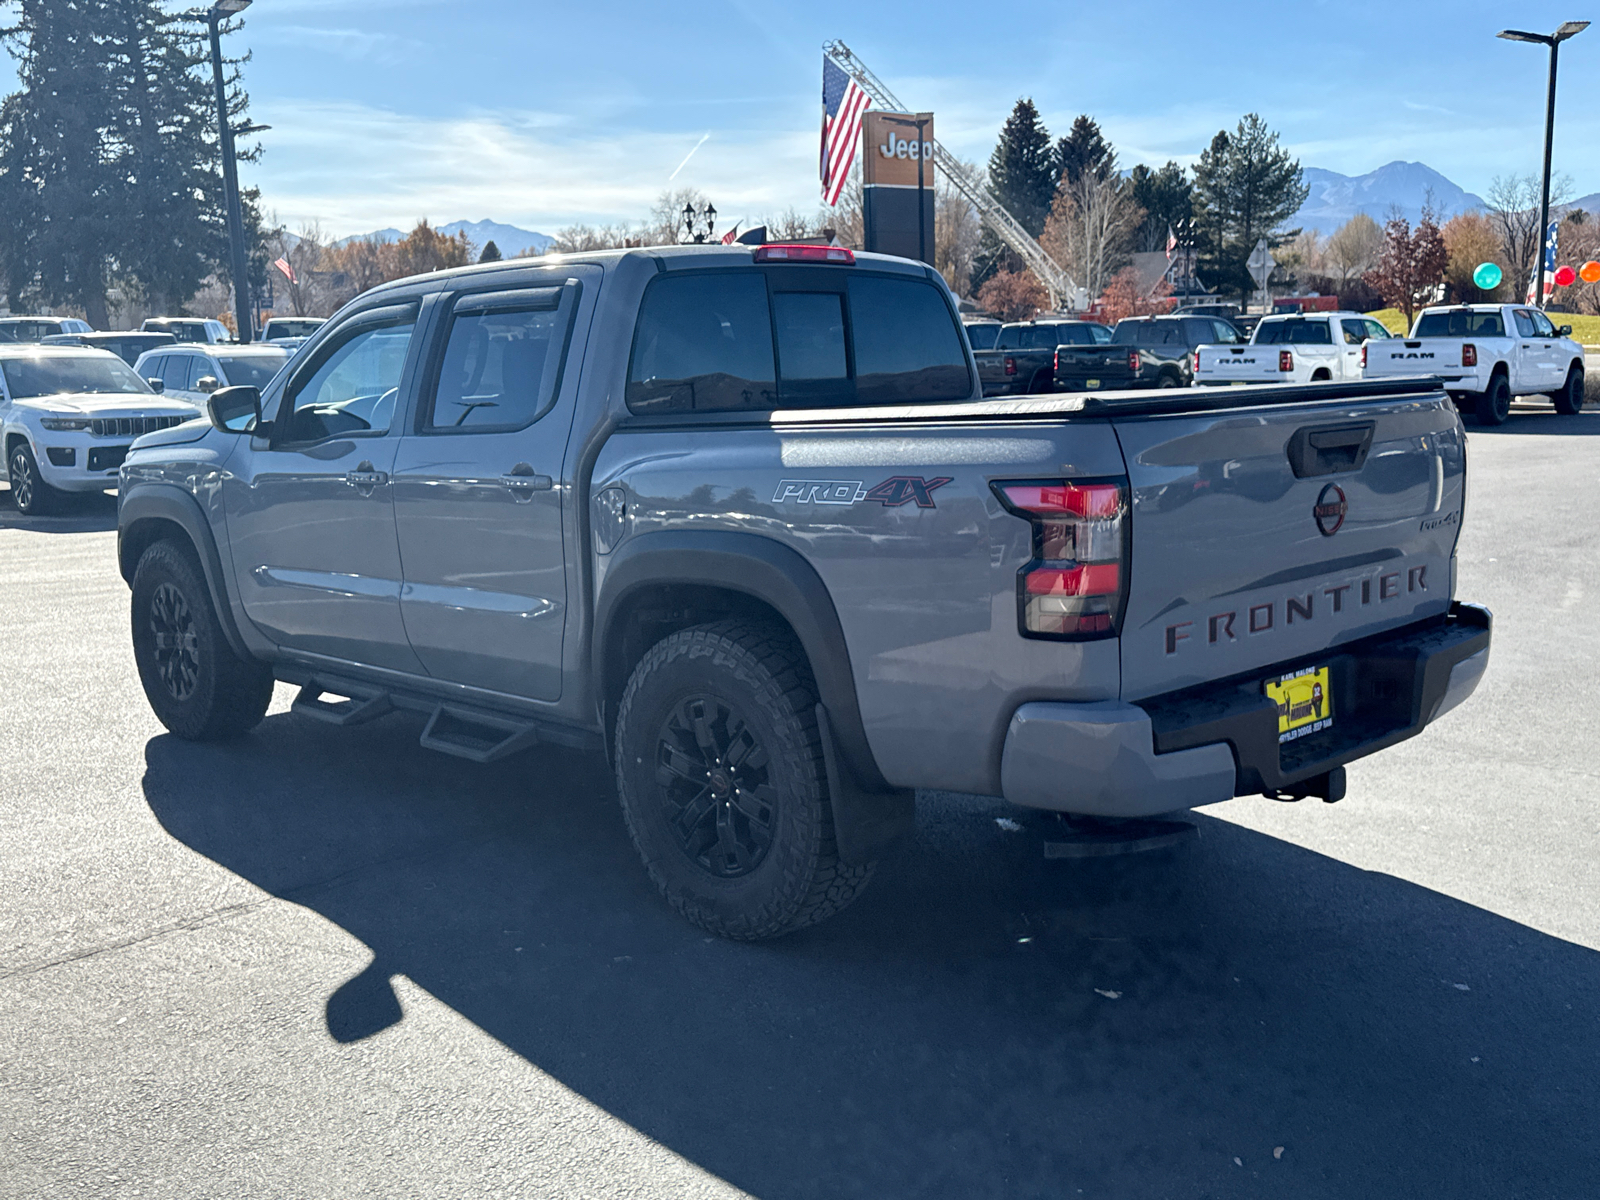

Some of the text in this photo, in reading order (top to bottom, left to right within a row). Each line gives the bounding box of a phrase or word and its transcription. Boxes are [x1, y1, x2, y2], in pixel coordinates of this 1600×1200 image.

[880, 132, 932, 160] Jeep
[1391, 352, 1435, 360] RAM
[772, 476, 955, 508] PRO-4X
[1315, 501, 1348, 517] NISS
[1165, 564, 1428, 656] FRONTIER
